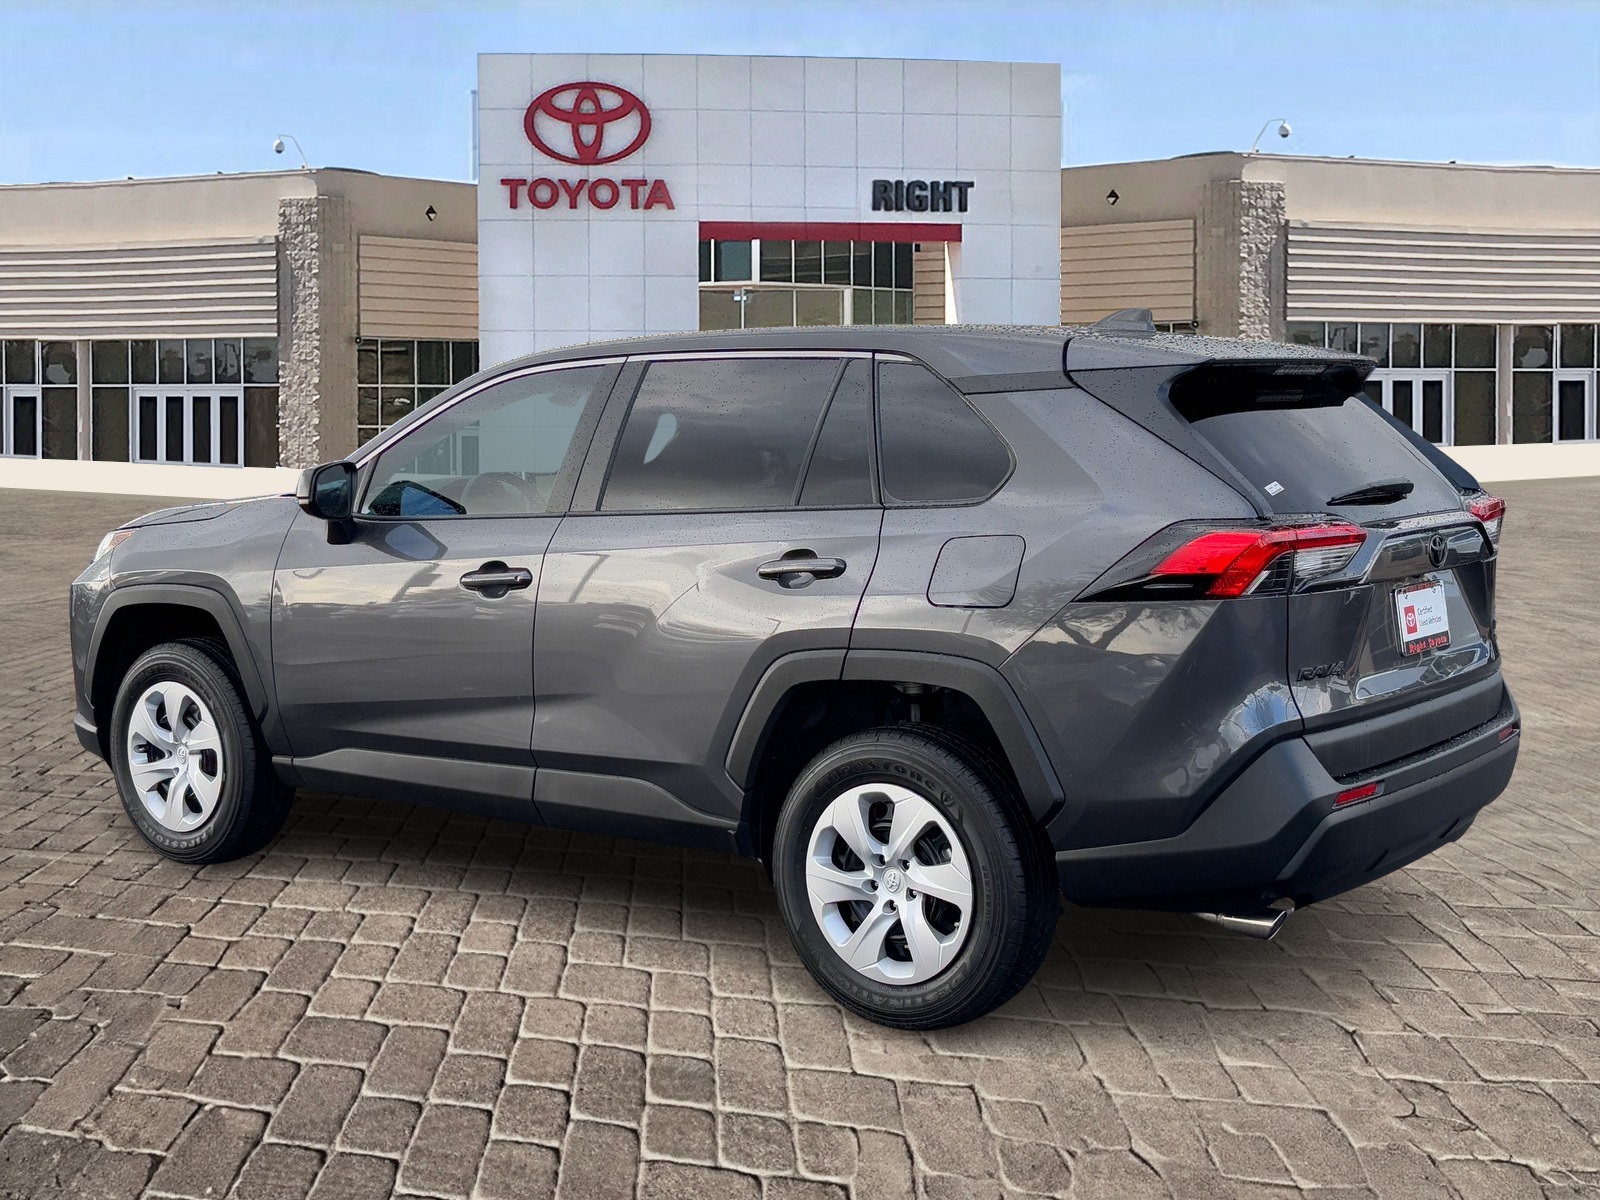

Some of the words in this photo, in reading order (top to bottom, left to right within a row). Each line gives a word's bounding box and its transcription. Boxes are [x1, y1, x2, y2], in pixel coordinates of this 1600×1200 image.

[500, 178, 675, 210] TOYOTA
[871, 179, 975, 213] RIGHT
[1408, 641, 1427, 654] Right
[1428, 635, 1447, 648] Toyota
[1297, 661, 1345, 682] RAV4
